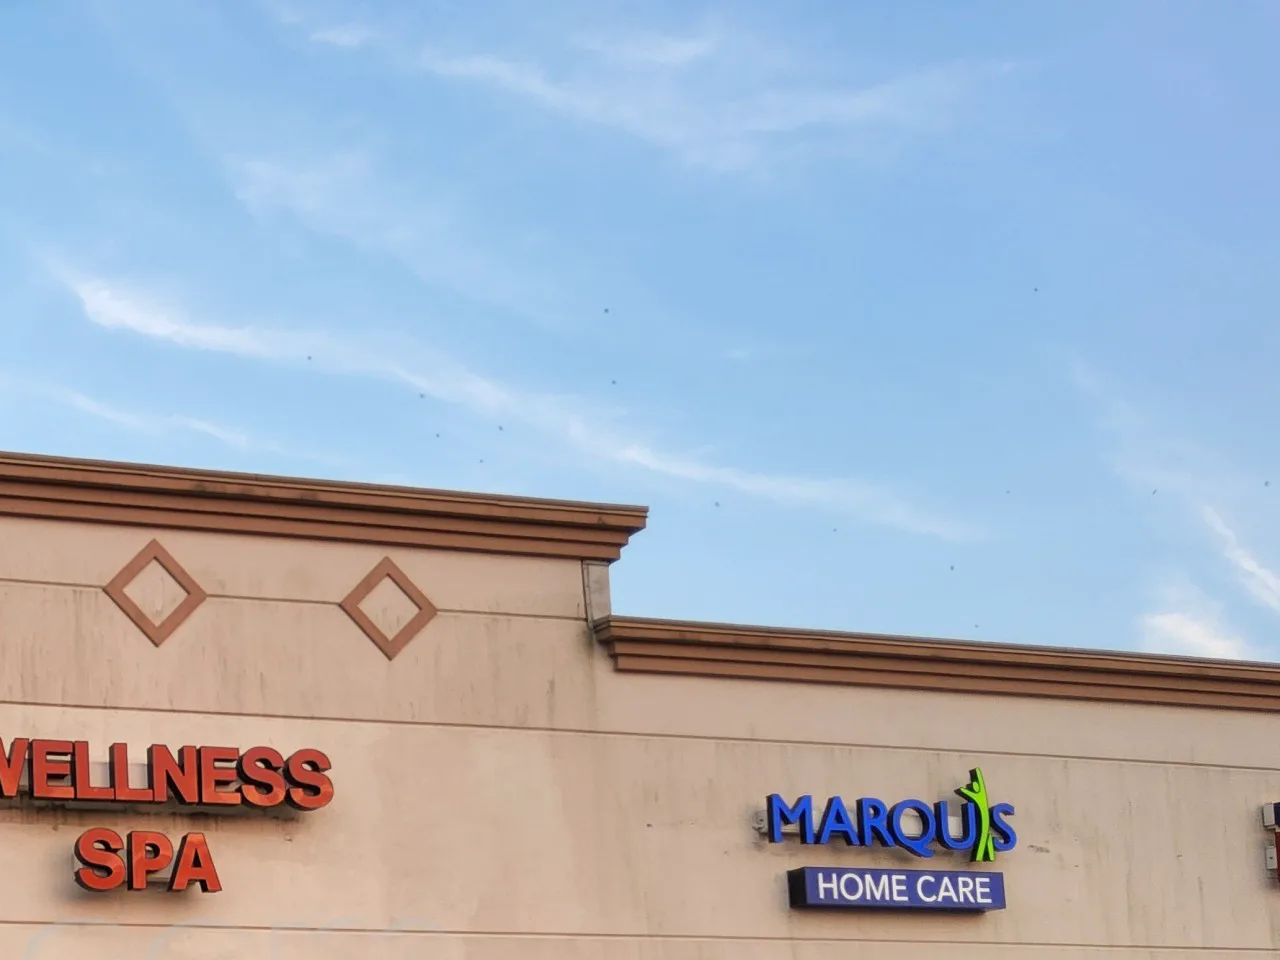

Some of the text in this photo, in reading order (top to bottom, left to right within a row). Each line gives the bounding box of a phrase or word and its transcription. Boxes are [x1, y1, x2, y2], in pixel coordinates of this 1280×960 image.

[74, 827, 222, 892] SPA
[817, 872, 992, 903] HOME CARE
